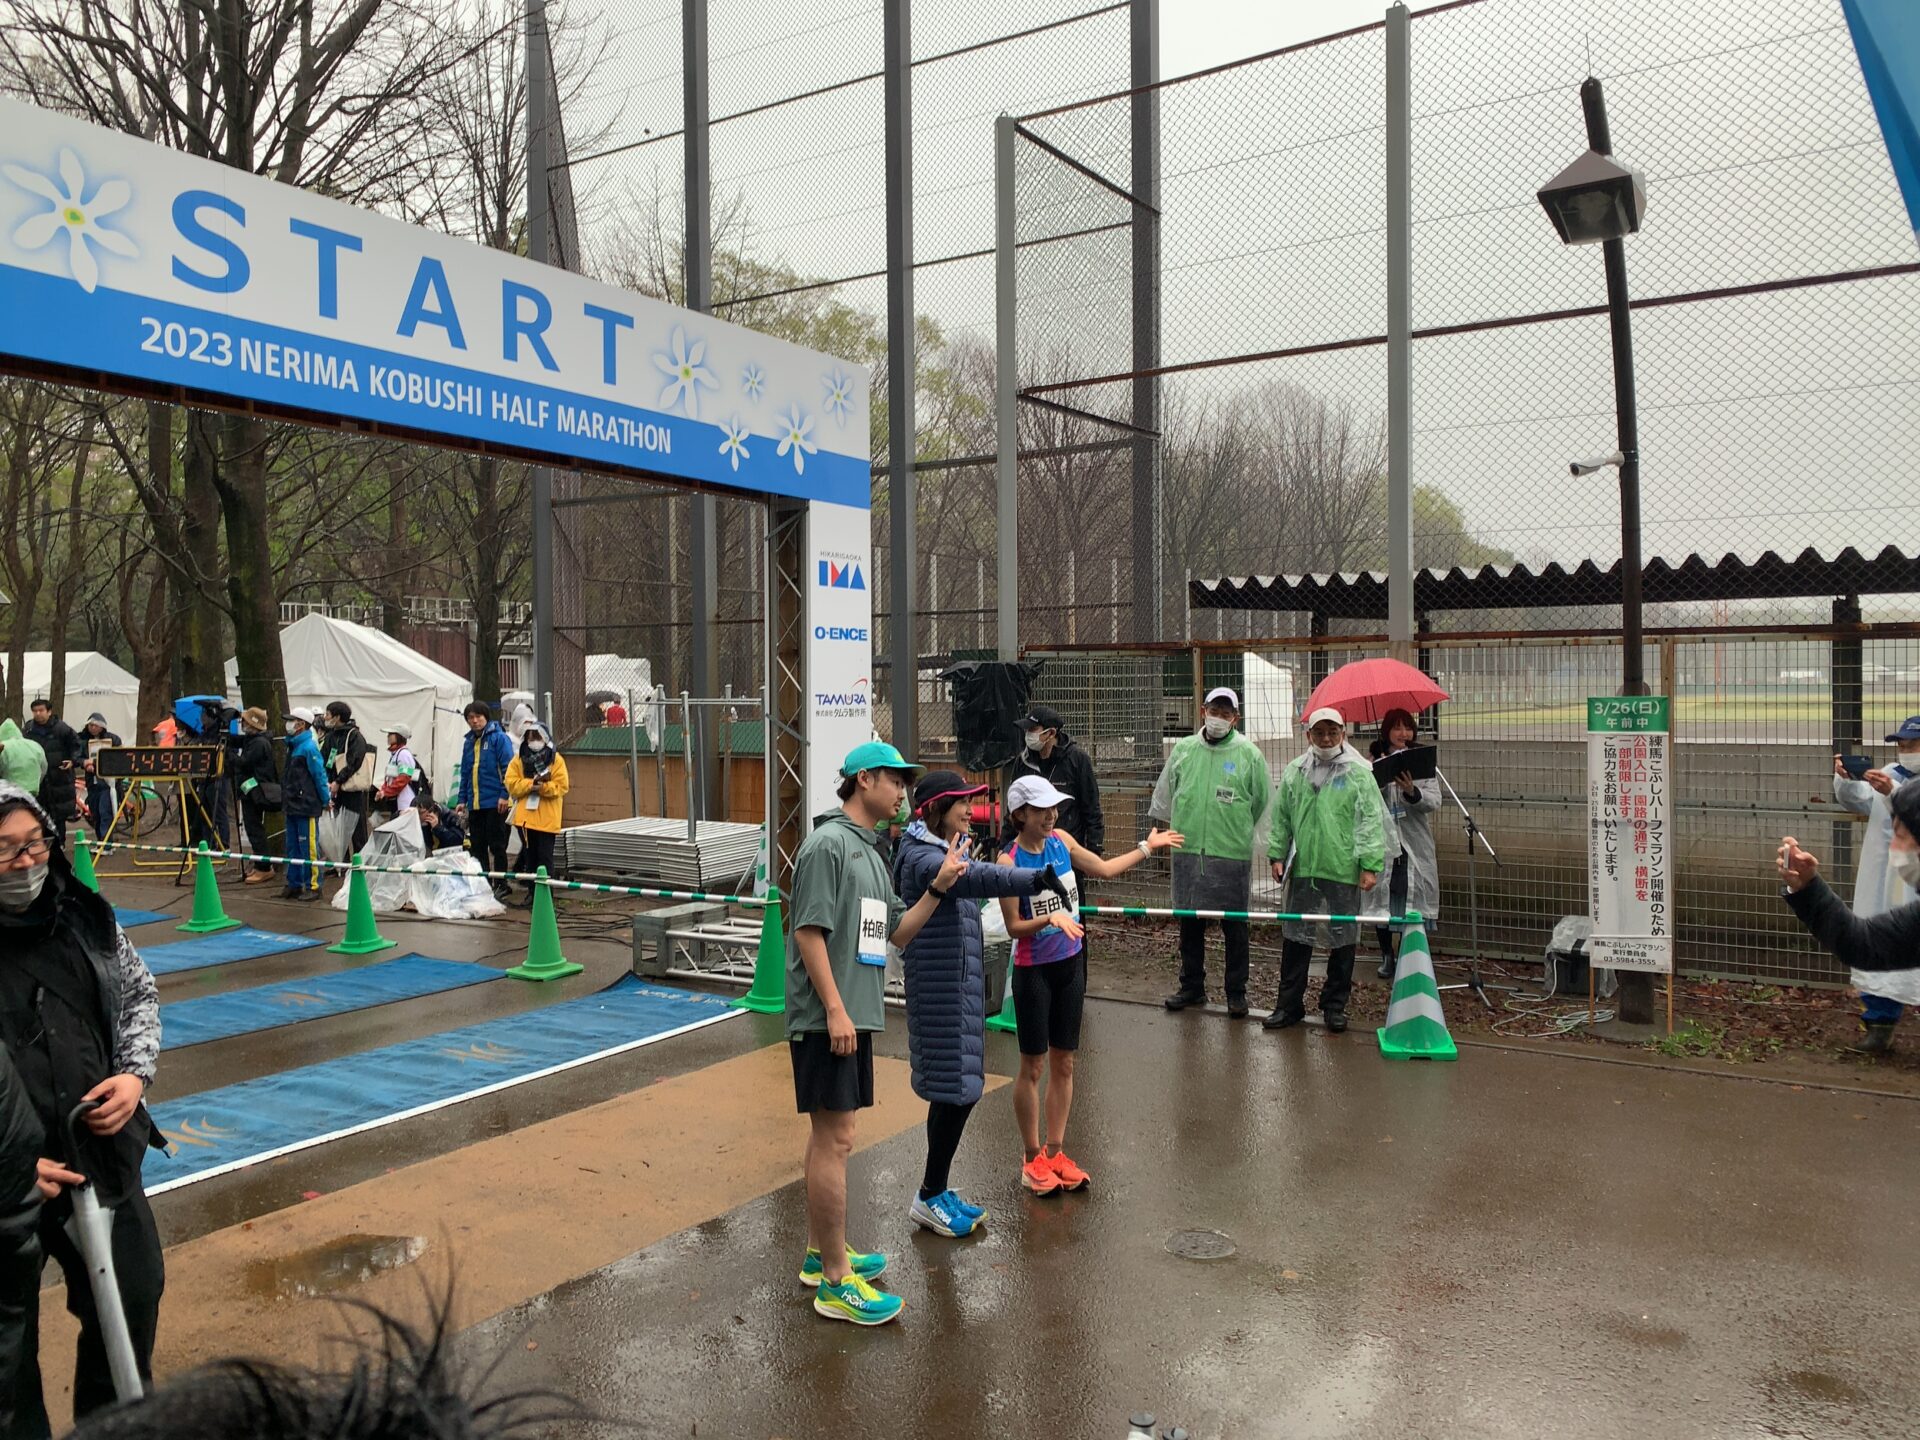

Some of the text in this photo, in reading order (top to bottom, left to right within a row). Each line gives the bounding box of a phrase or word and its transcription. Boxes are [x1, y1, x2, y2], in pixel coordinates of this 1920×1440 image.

[172, 189, 634, 385] START
[141, 316, 672, 454] 2023 NERIMA KOBUSHI HALF MARATHON
[819, 559, 866, 590] IMA
[815, 694, 867, 706] TAMURA
[1594, 701, 1661, 716] 3/26(日)
[1606, 717, 1649, 729] 午前中
[1618, 739, 1632, 824] 一部制限します。
[1604, 736, 1618, 882] ご協力をお願いいたします。
[1633, 735, 1649, 902] 公園入口・園路の通行・横断を
[1648, 735, 1665, 936] 練馬こぶしハーフマラソン開催のため
[862, 918, 888, 940] 柏原
[1594, 940, 1666, 952] 練馬こぶしハーフマラソン
[1612, 949, 1647, 958] 実行委員会
[930, 1203, 952, 1226] HOKA
[841, 1290, 871, 1311] HOKA
